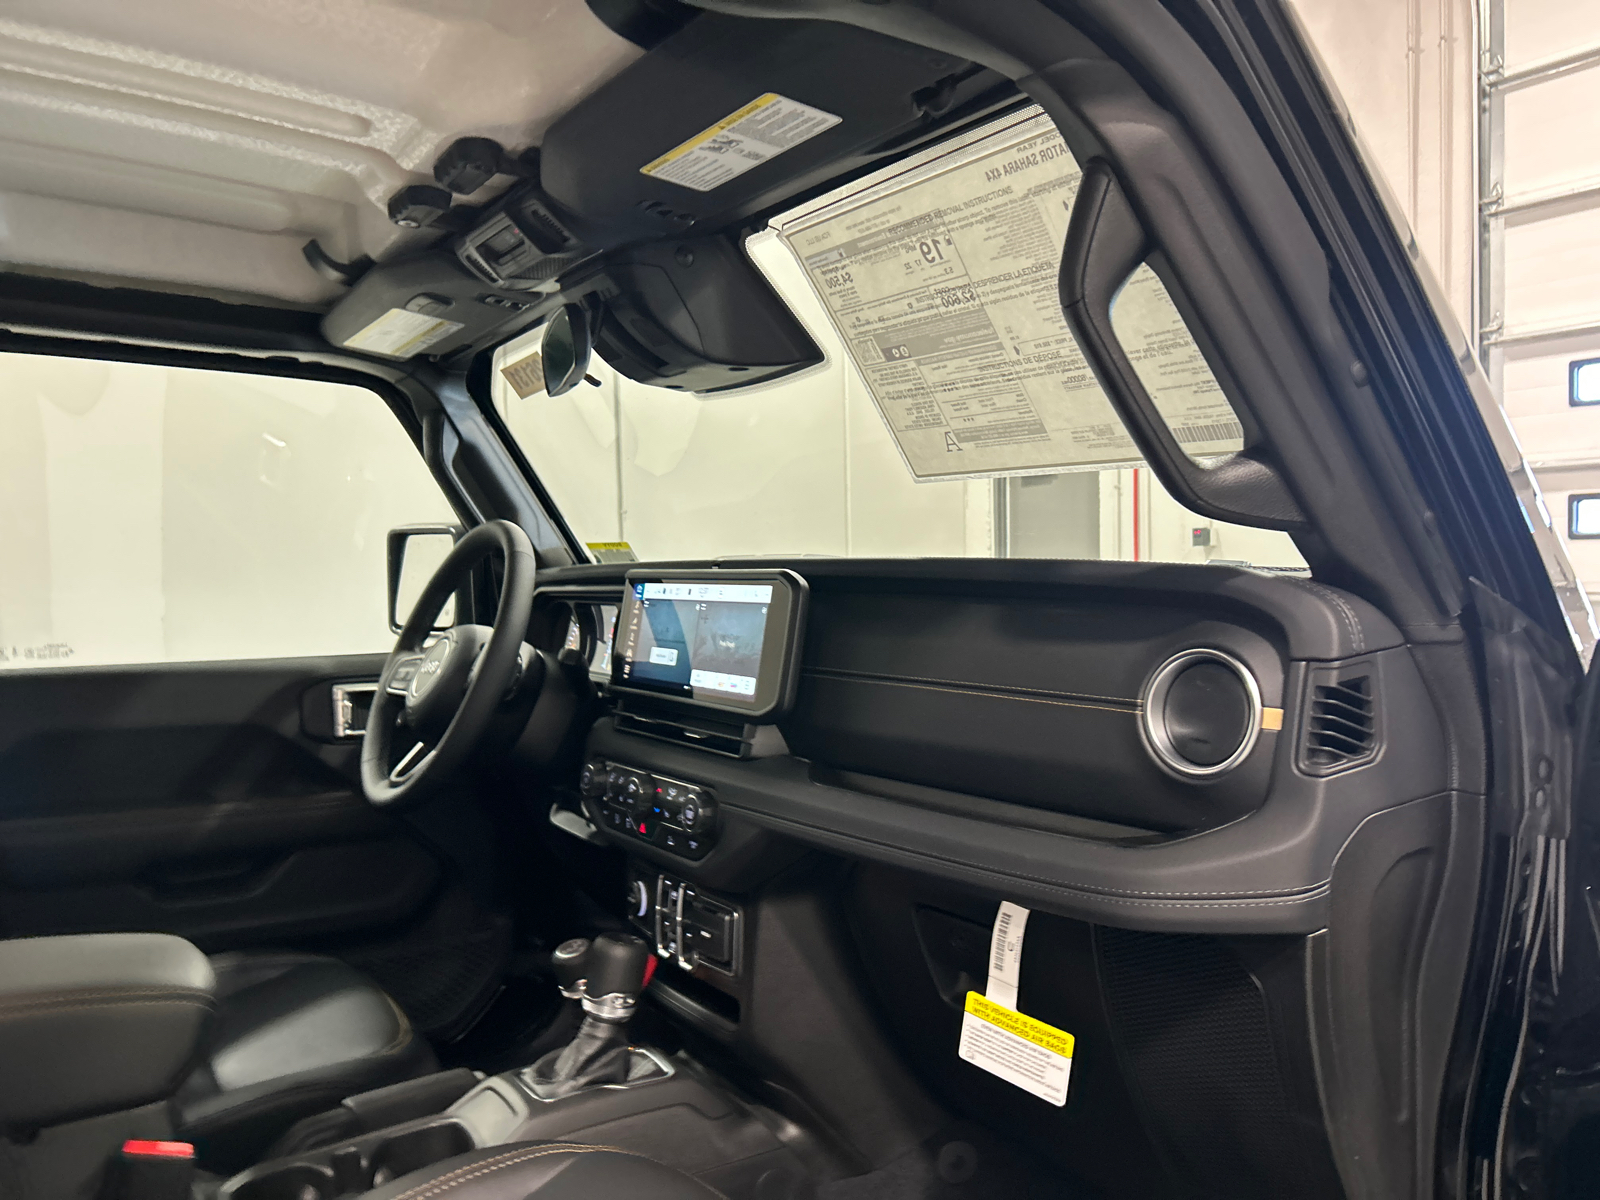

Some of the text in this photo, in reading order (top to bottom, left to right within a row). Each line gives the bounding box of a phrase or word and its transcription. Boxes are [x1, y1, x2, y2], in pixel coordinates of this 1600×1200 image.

[963, 186, 1012, 208] INSTRUCTIONS
[972, 272, 1013, 288] DESPRENDER
[972, 998, 989, 1010] THIS
[990, 1004, 1020, 1024] VEHICLE
[1029, 1024, 1069, 1046] EQUIPPED
[972, 1006, 1067, 1054] WITH ADVANCED AIR BAGS
